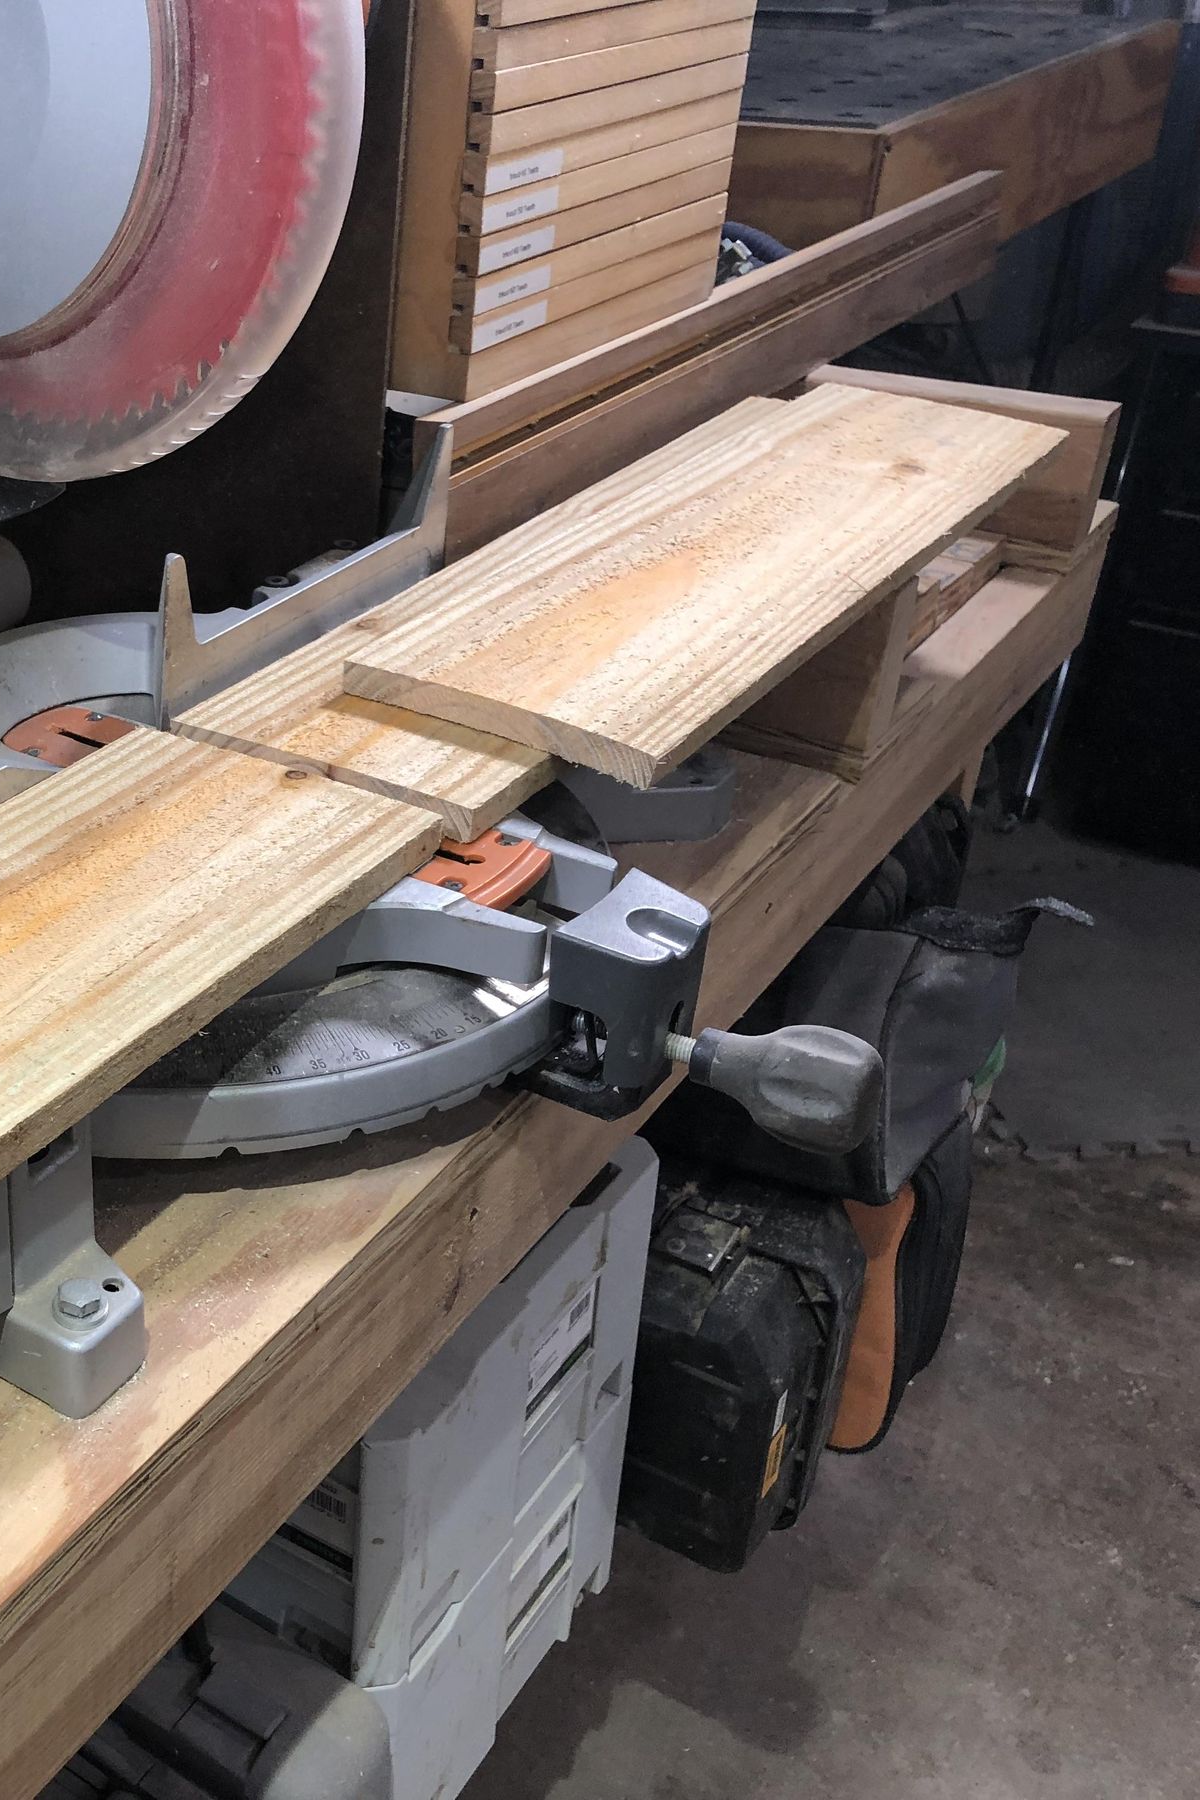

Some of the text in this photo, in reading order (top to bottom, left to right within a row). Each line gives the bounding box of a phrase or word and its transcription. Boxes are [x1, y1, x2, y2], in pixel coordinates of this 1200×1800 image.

[309, 1058, 328, 1071] 35
[352, 1050, 371, 1062] 30
[392, 1039, 411, 1052] 25
[430, 1027, 448, 1041] 20
[464, 1013, 483, 1026] 15
